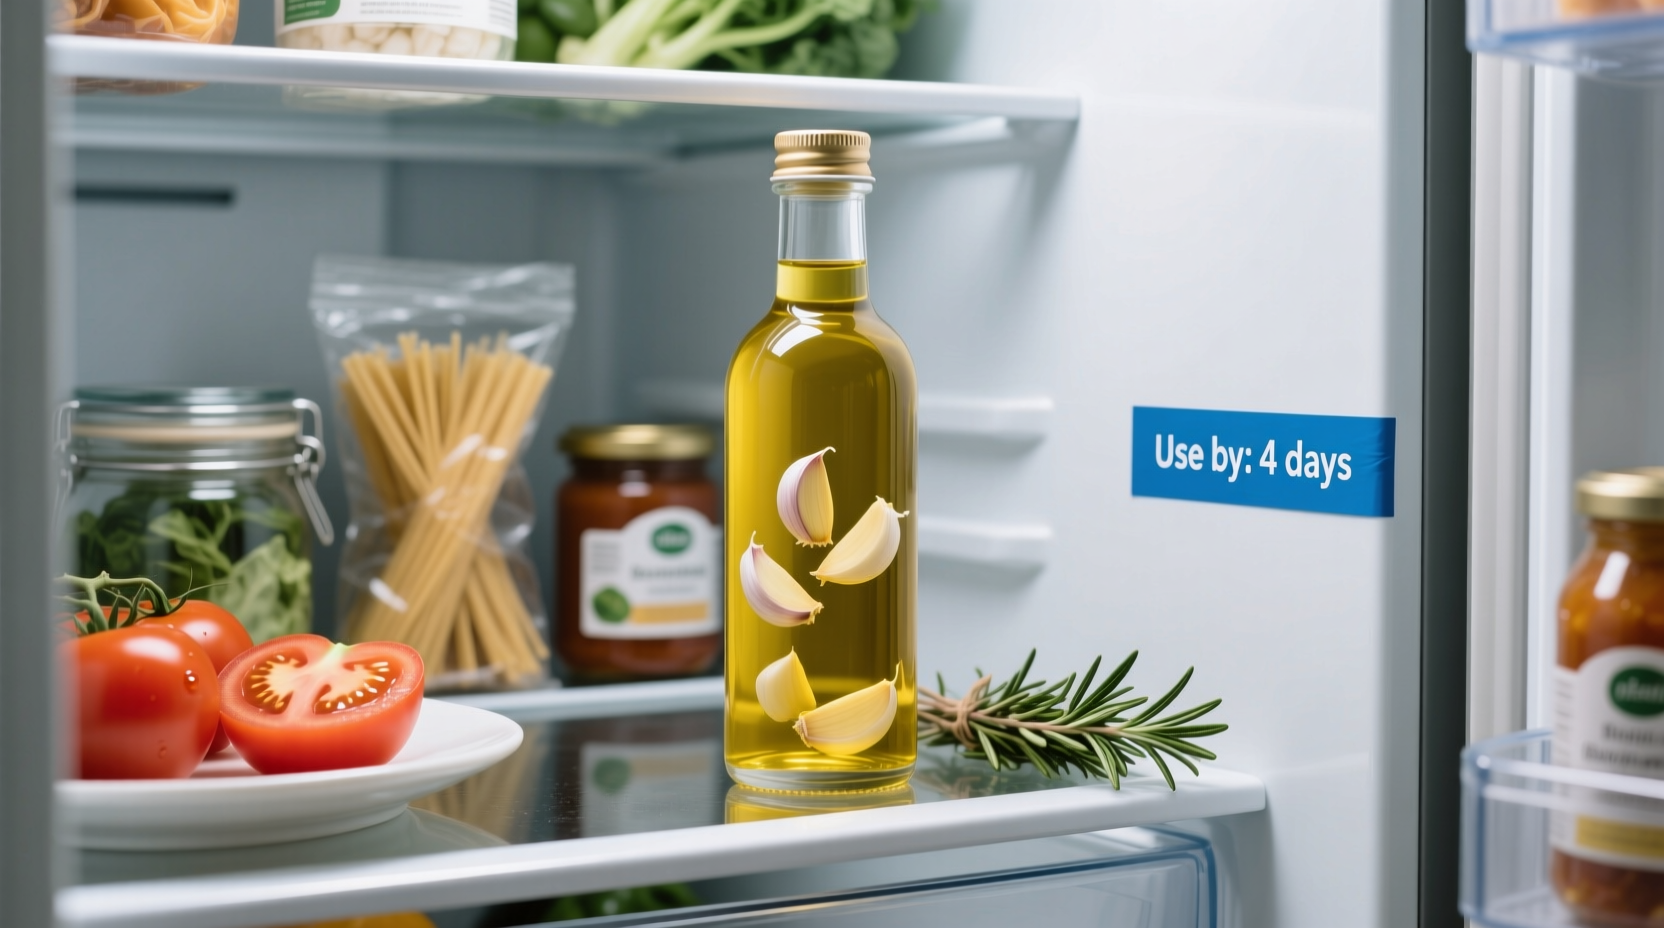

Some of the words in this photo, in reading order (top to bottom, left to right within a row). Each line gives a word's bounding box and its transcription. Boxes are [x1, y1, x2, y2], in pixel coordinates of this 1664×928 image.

[1155, 433, 1204, 471] Use
[1211, 435, 1252, 482] by:
[1259, 439, 1277, 475] 4
[1285, 439, 1352, 489] days
